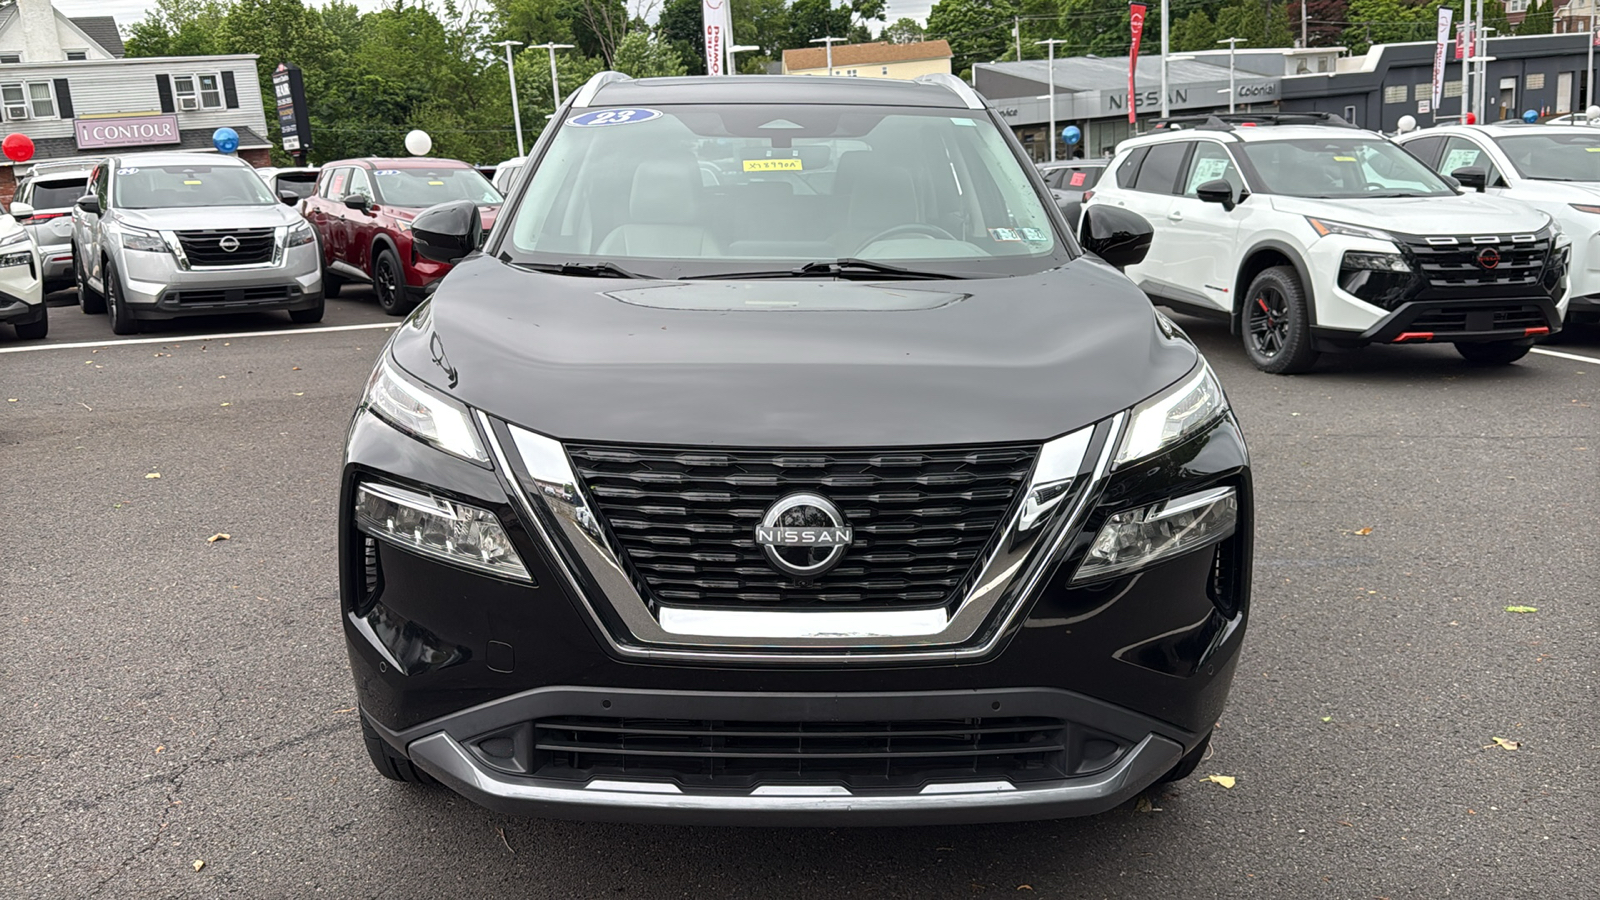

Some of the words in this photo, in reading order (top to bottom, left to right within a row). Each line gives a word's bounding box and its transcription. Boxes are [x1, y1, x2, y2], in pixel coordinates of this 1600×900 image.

[1239, 83, 1276, 97] Colonial
[587, 110, 636, 125] 23
[93, 123, 172, 140] CONTOUR
[759, 529, 850, 543] NISSAN
